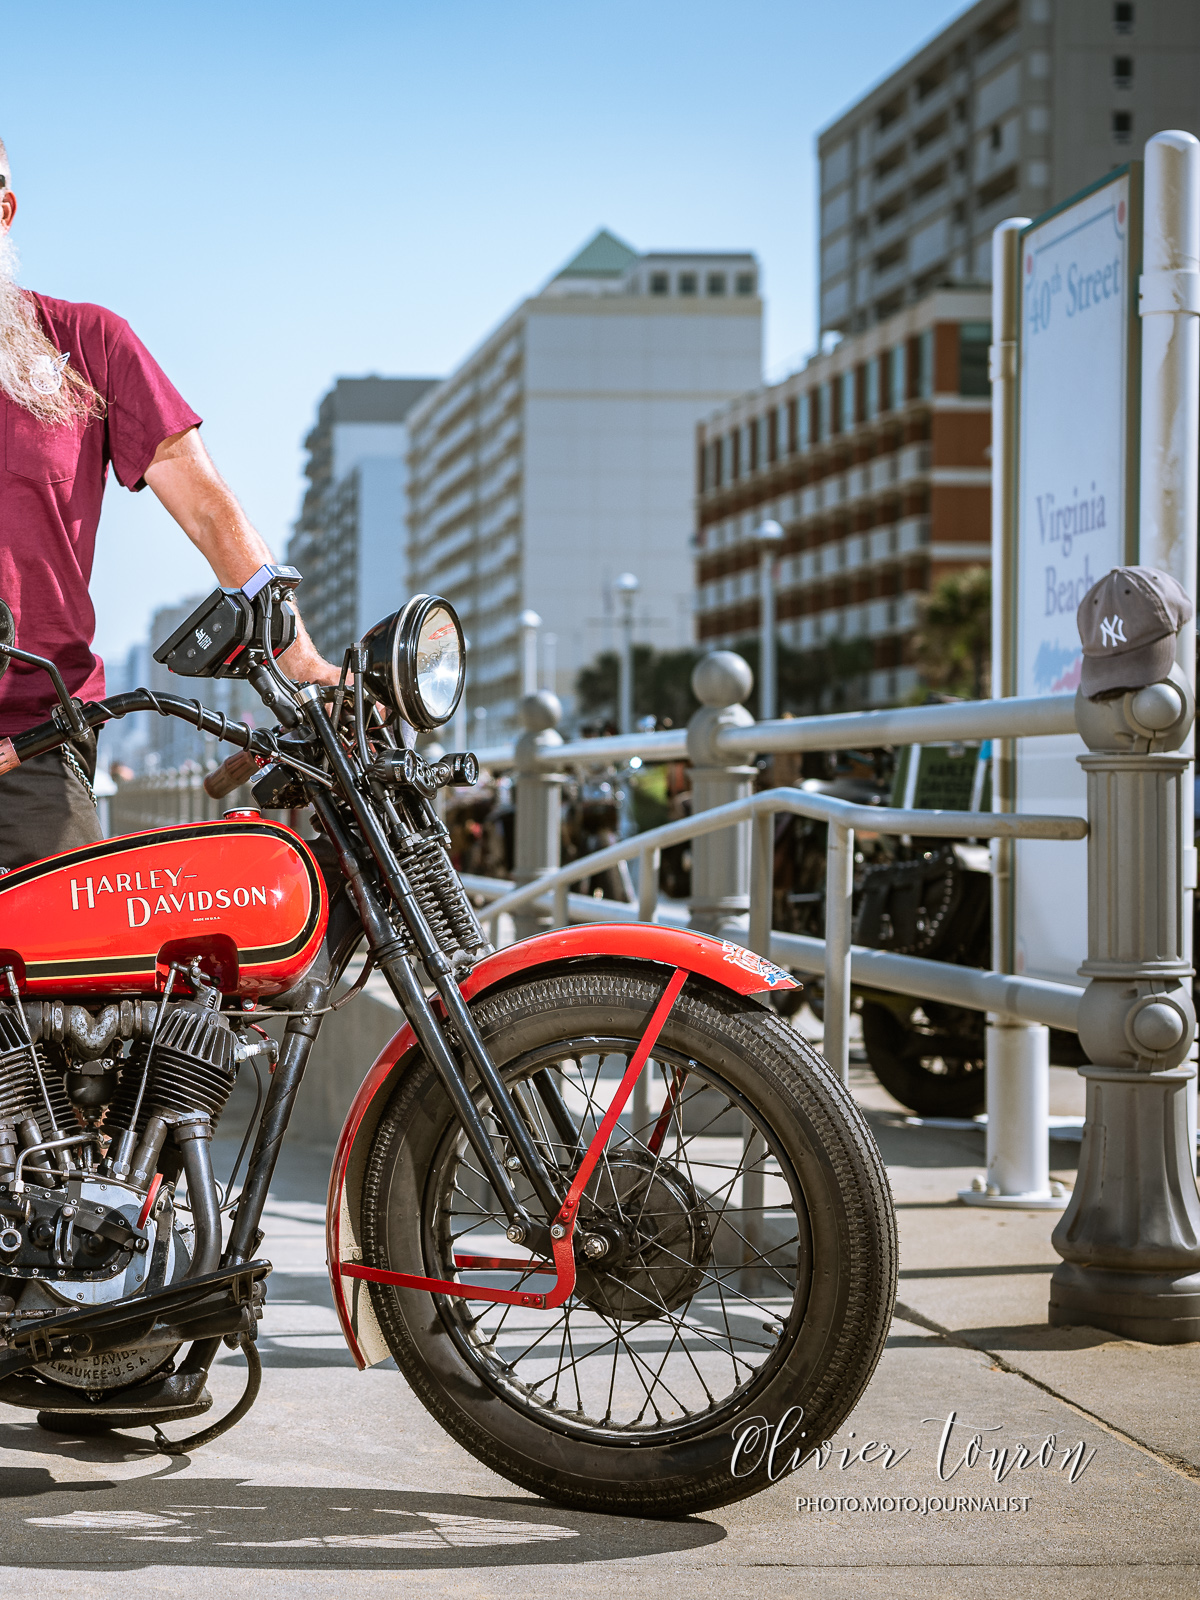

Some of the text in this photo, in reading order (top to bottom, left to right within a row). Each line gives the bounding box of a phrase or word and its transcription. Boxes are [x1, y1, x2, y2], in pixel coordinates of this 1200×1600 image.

[1029, 255, 1120, 334] 40th Street
[1036, 481, 1106, 558] Virginia
[1100, 614, 1128, 648] NY
[126, 885, 268, 929] DAVIDSON
